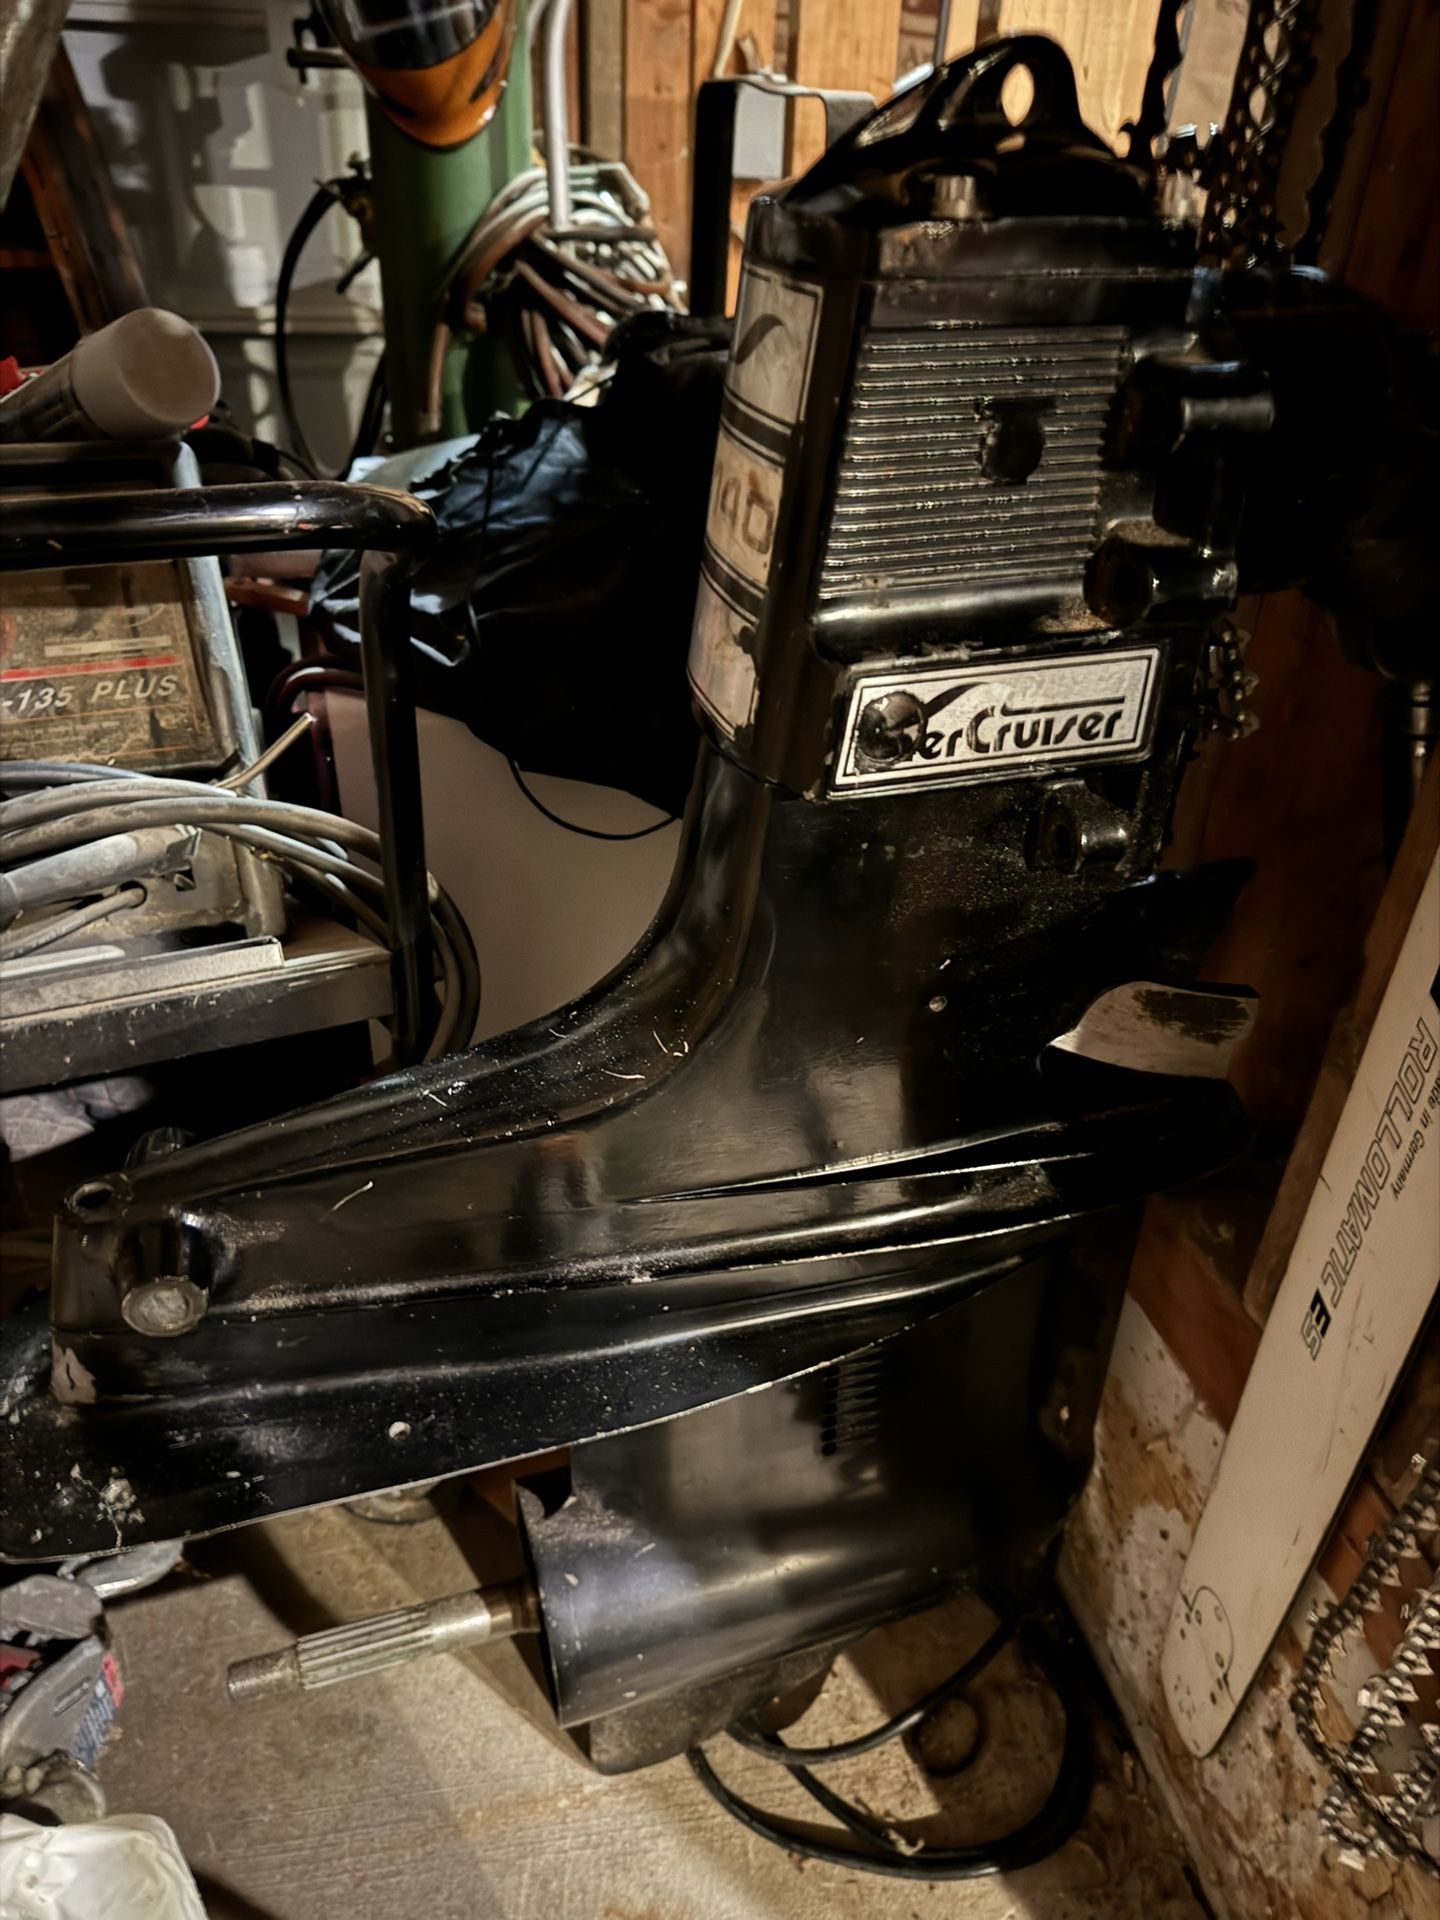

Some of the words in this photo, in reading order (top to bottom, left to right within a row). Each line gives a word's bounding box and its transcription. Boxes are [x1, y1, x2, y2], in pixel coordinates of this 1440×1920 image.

[90, 675, 178, 704] PLUS
[895, 704, 1123, 761] erCruiser
[1420, 1107, 1433, 1129] in
[1321, 1017, 1438, 1309] ROLLOMATIC
[1391, 1130, 1425, 1200] Germany
[1301, 1288, 1332, 1361] ES
